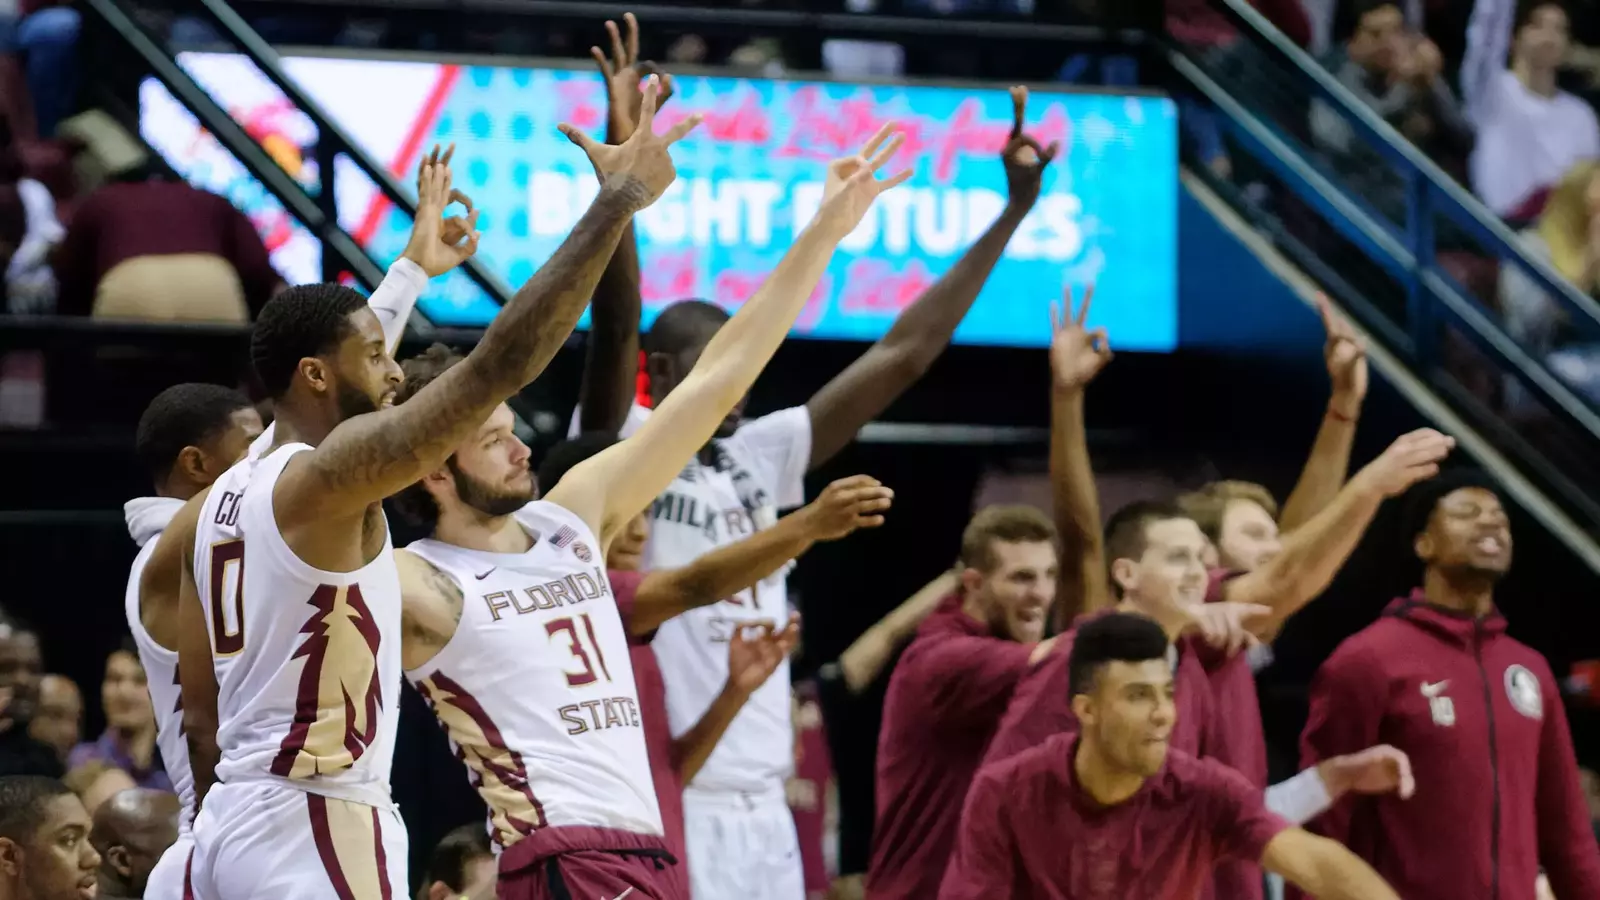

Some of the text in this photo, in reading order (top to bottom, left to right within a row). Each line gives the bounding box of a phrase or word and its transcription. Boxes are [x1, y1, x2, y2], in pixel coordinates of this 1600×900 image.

[531, 170, 1082, 262] BGHT FUTURS
[483, 566, 610, 622] FLORIDA
[543, 612, 613, 688] 31
[558, 697, 640, 735] STATE
